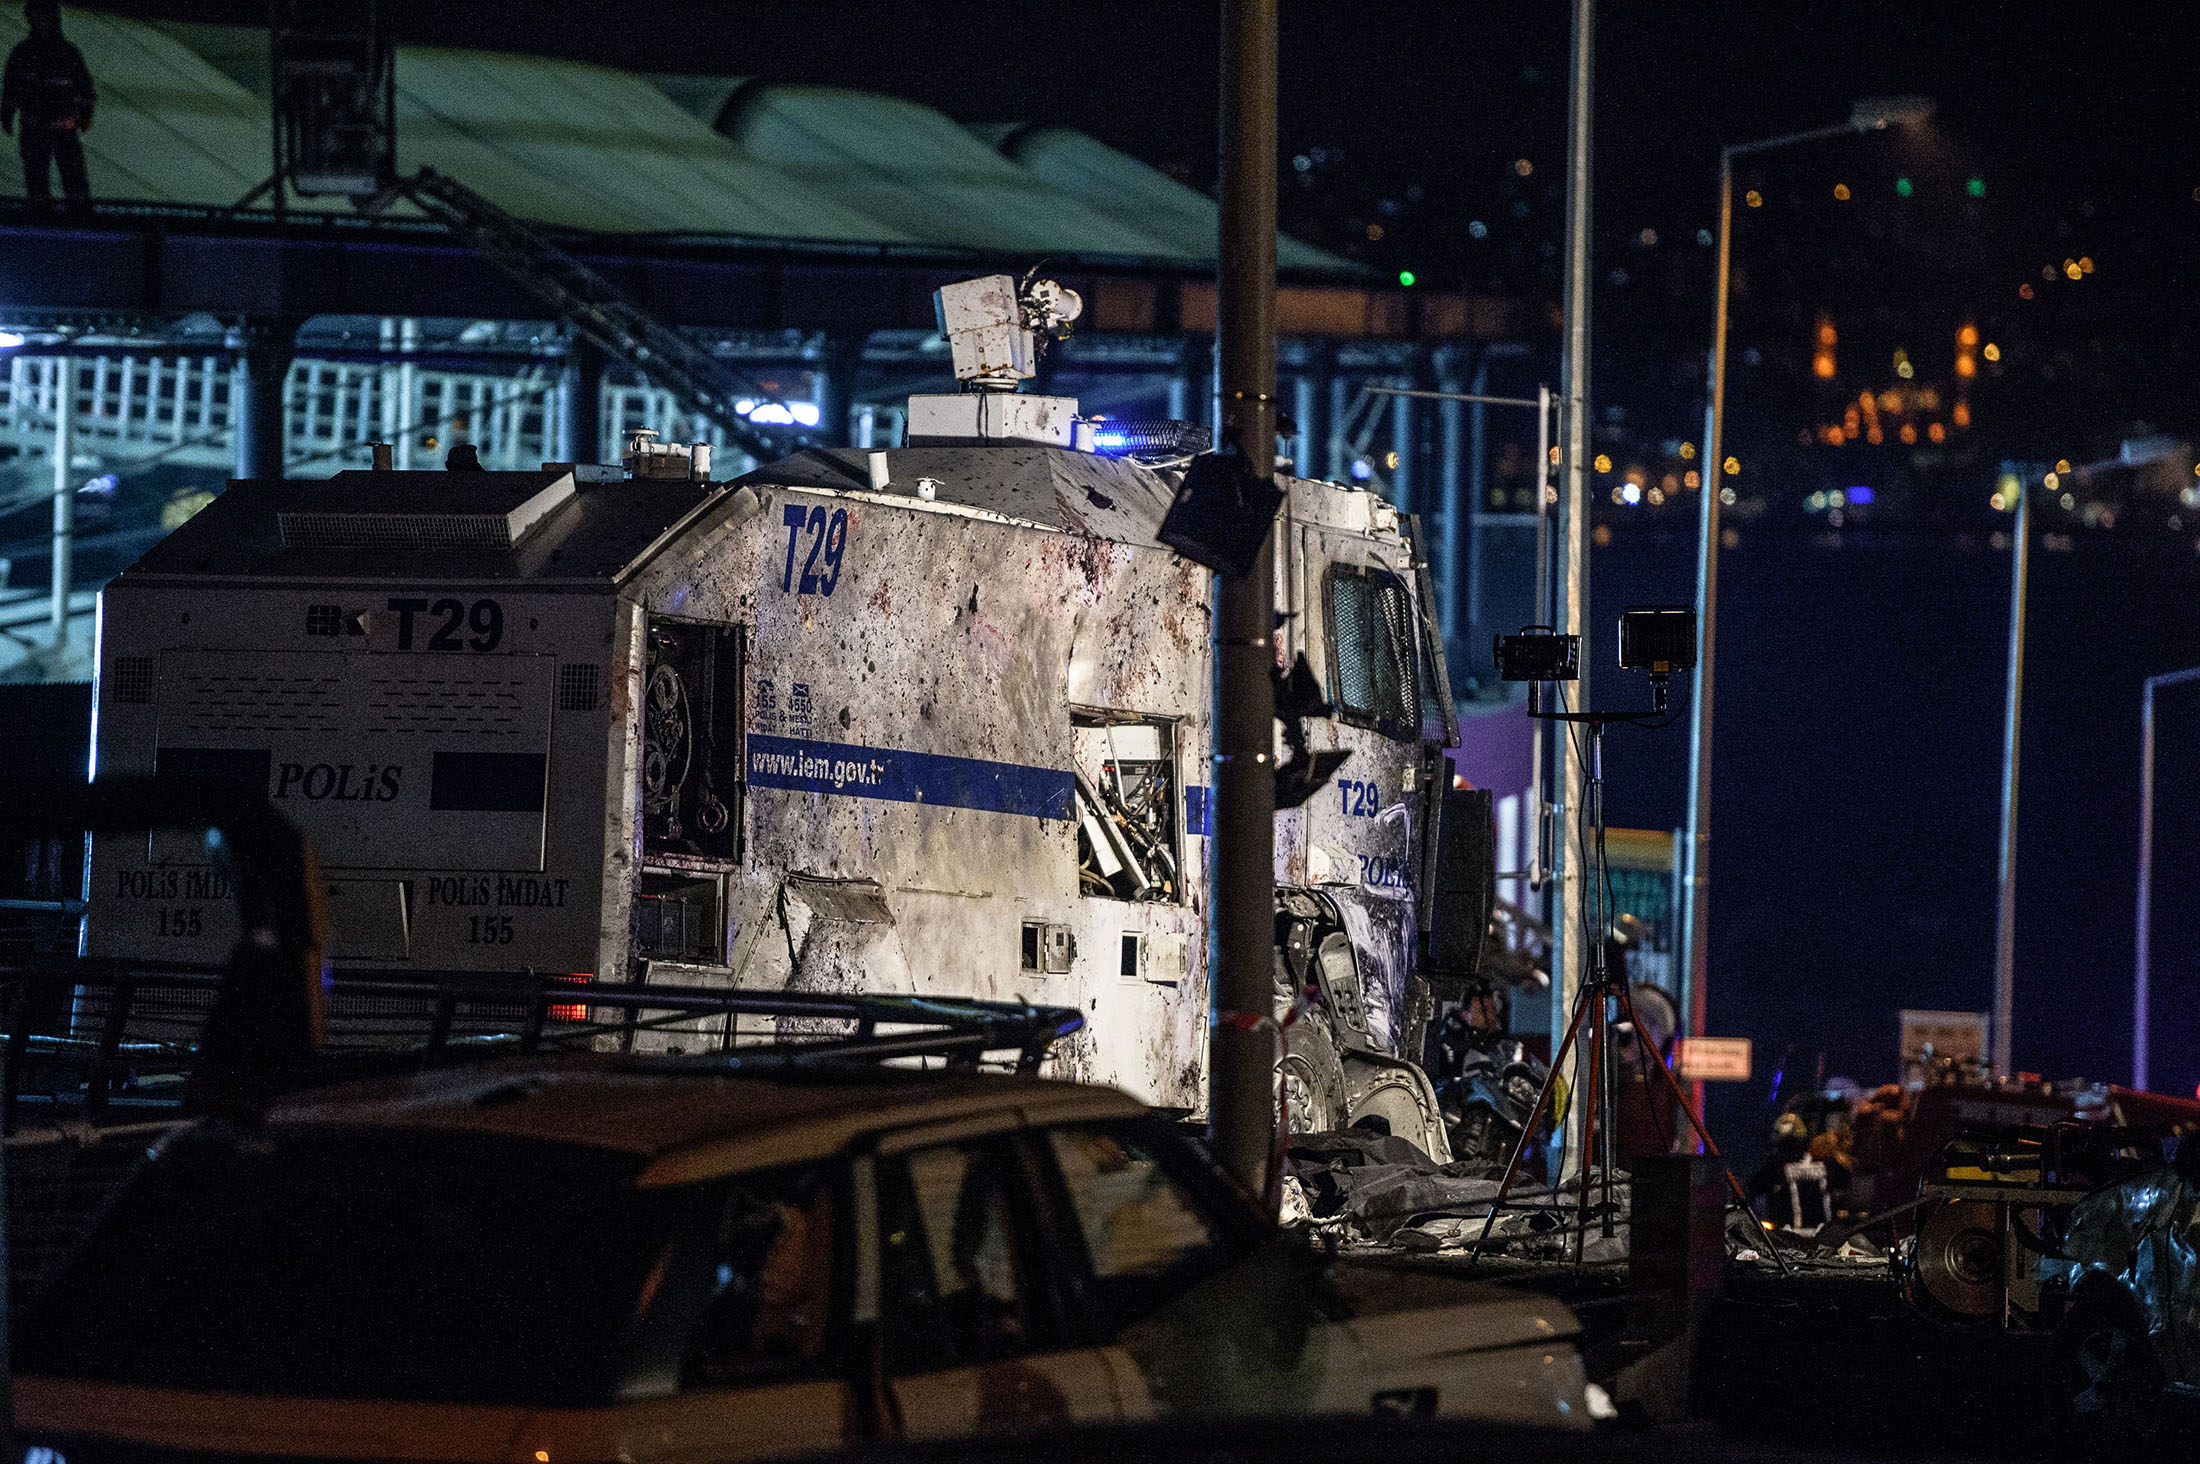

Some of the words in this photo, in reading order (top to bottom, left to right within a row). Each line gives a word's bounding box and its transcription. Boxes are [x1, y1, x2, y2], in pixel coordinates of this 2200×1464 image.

[783, 504, 848, 598] T29
[387, 598, 504, 652] T29
[755, 693, 776, 709] 155
[1337, 779, 1379, 819] T29
[157, 907, 203, 938] 155
[468, 915, 515, 945] 155
